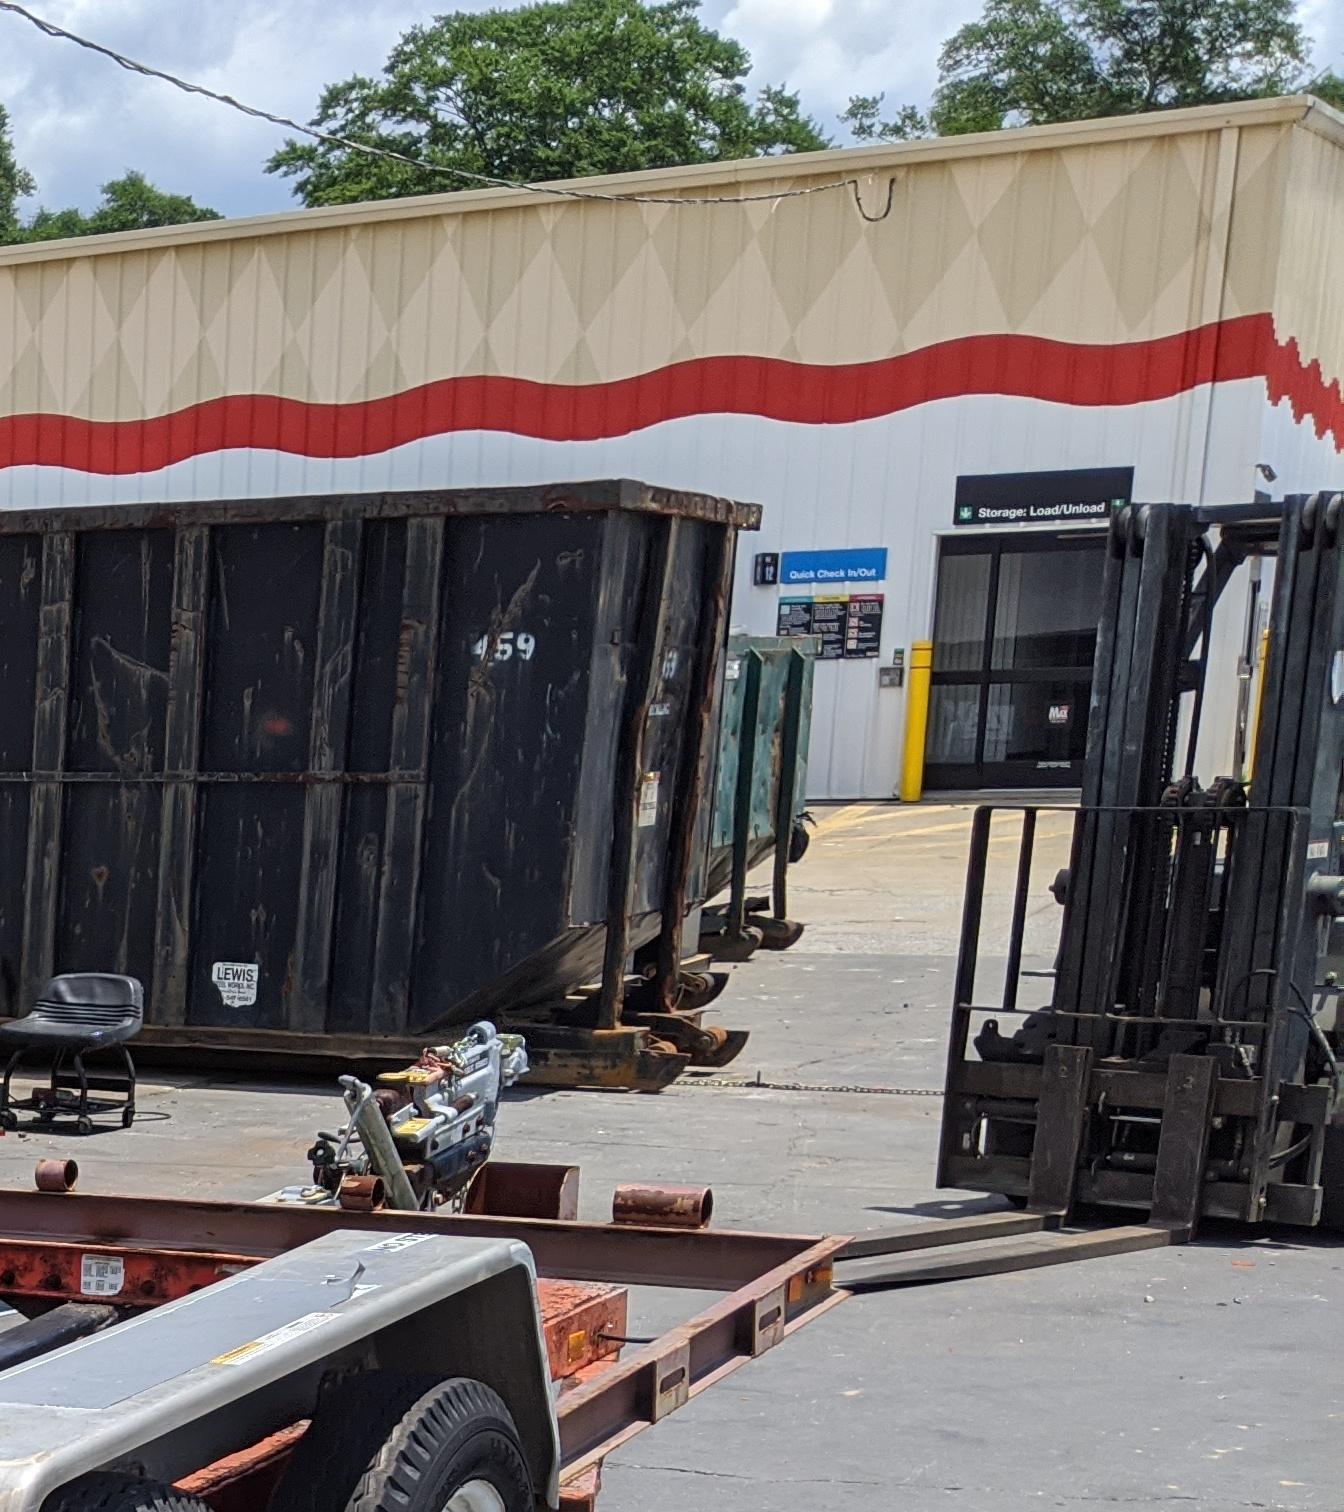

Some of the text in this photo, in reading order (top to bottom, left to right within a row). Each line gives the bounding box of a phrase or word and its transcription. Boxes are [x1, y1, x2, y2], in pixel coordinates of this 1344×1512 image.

[978, 502, 1105, 519] Storage: Load/Unload
[789, 568, 876, 580] Quick Check In/Out
[470, 631, 536, 664] 459
[217, 967, 253, 982] LEWIS
